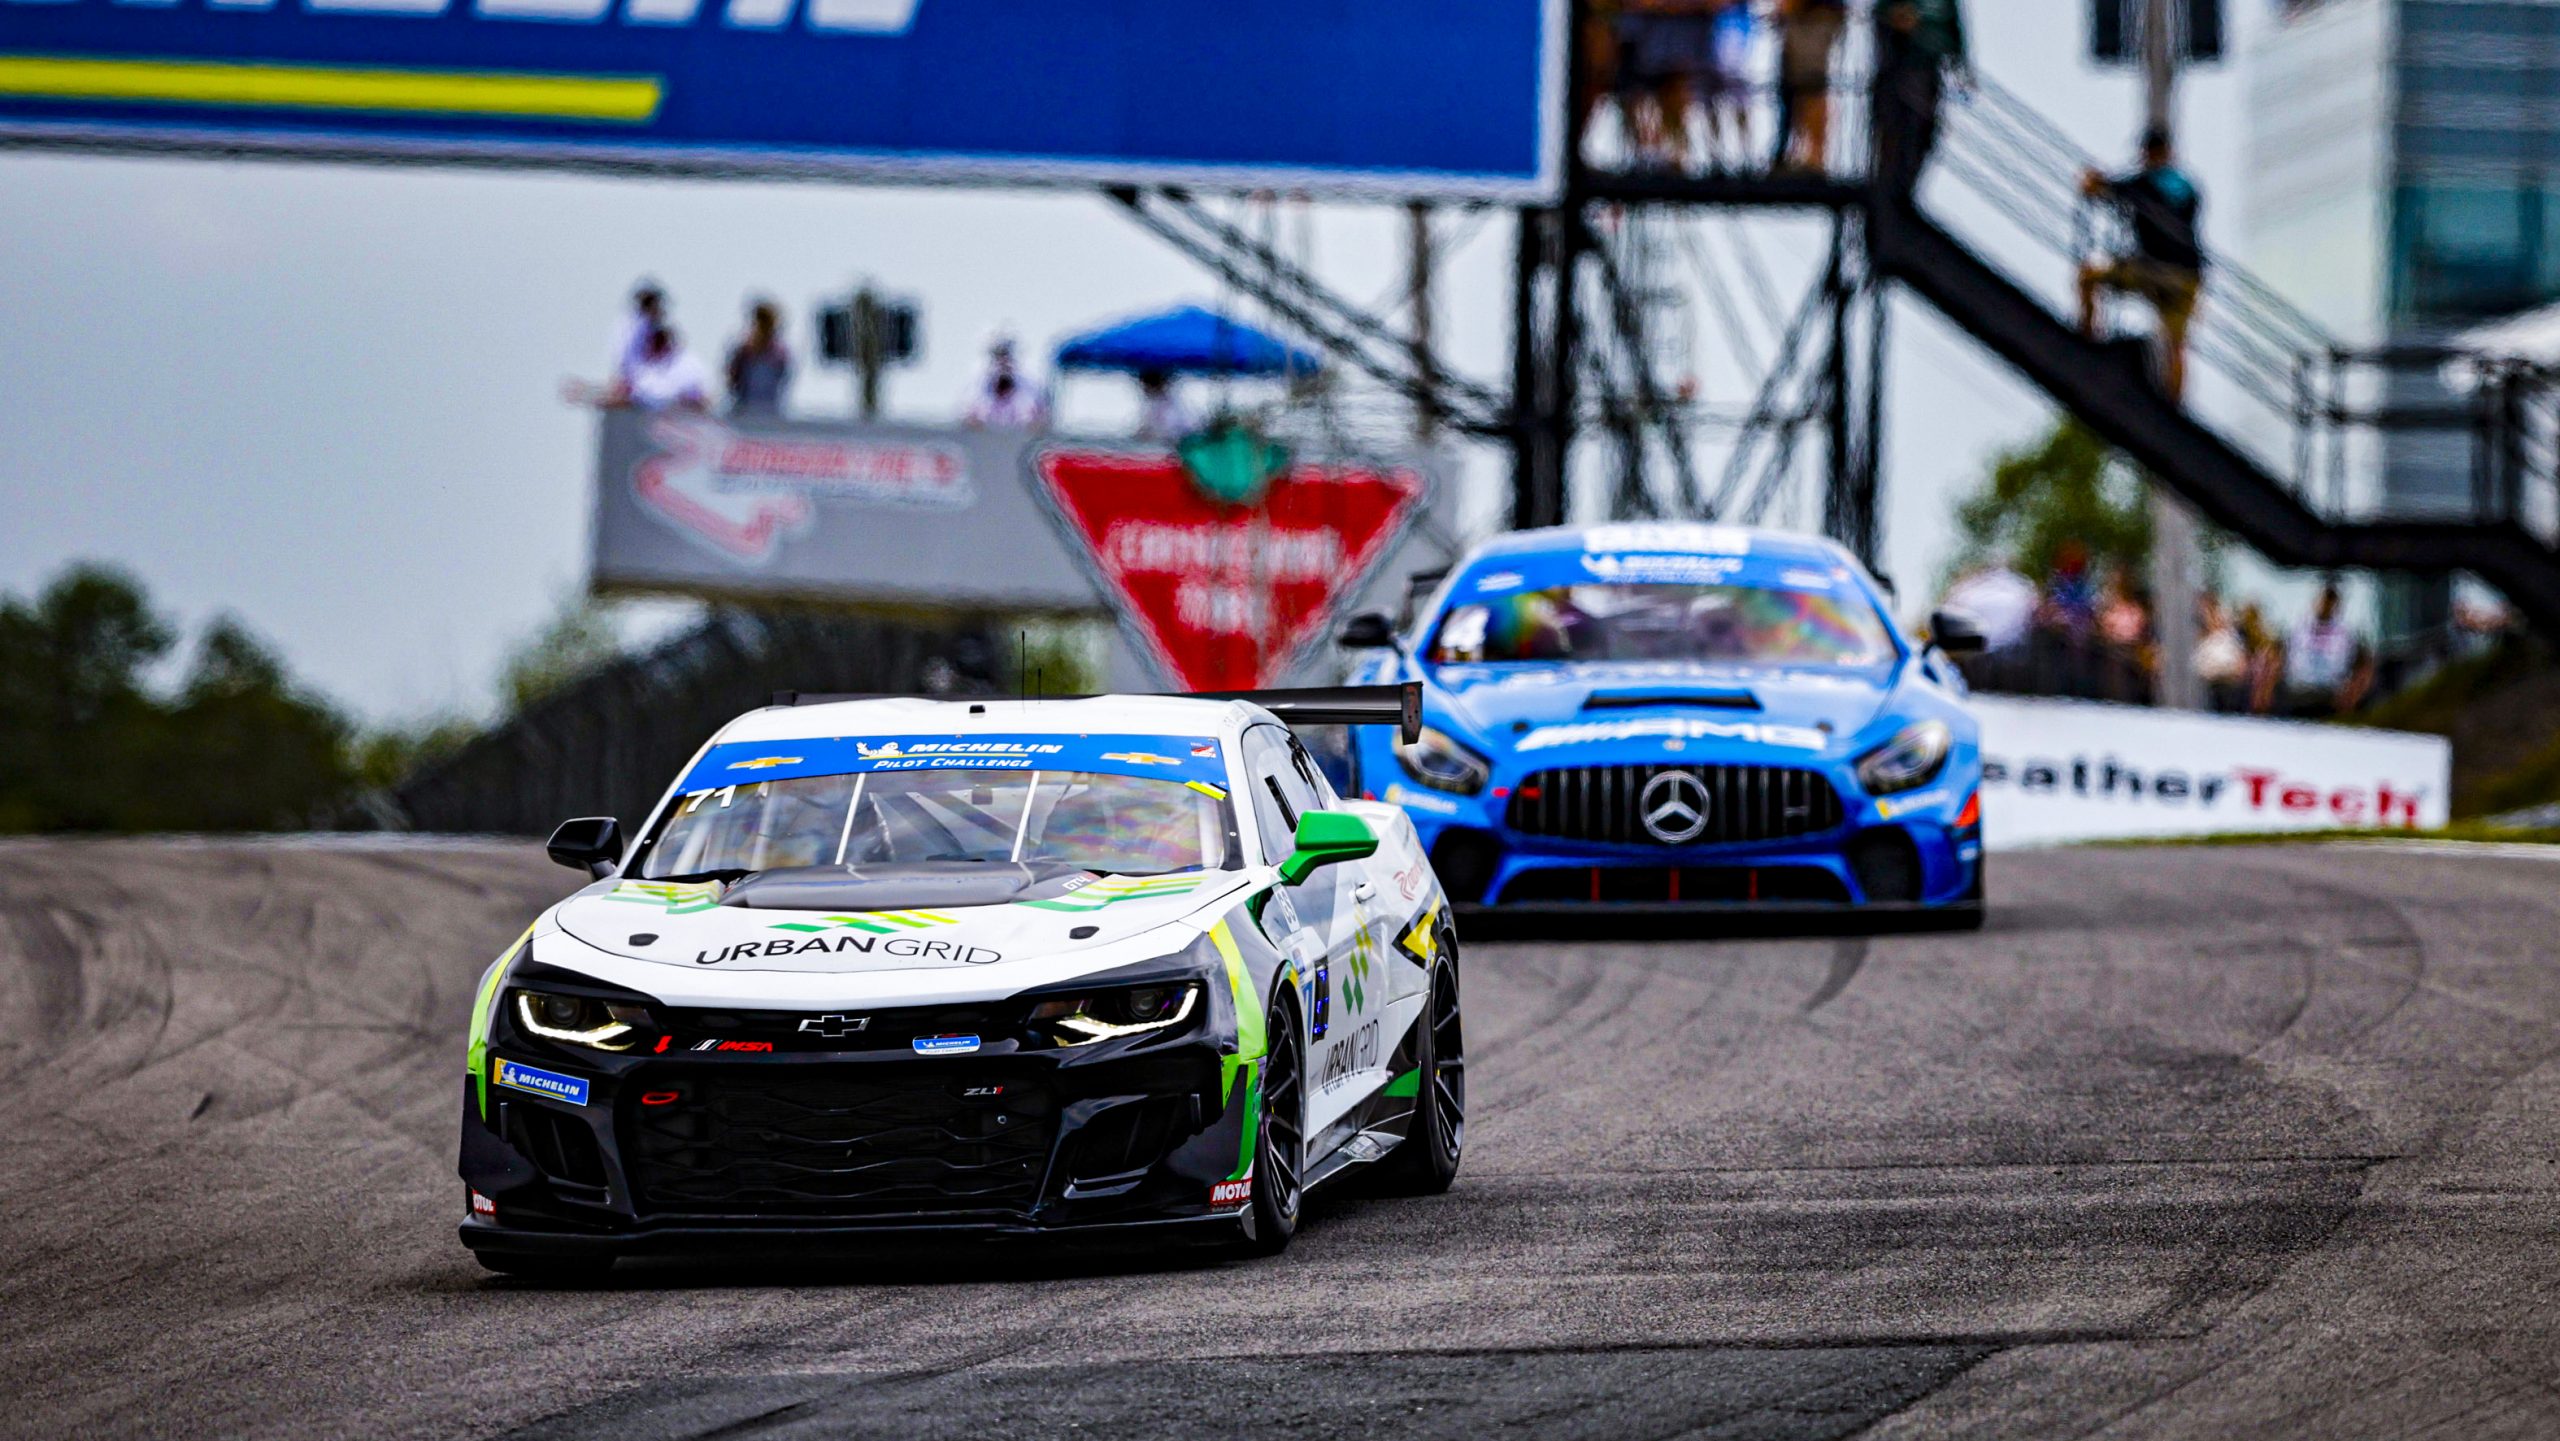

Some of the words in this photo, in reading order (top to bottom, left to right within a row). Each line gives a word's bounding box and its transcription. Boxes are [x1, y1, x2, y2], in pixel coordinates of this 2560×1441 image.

[907, 743, 1064, 754] MICHELIN
[873, 759, 928, 769] PILOT
[931, 757, 1034, 768] CHALLENGE
[686, 784, 737, 813] 71
[1982, 756, 2420, 829] eatherTech
[695, 936, 877, 965] URBAN
[884, 938, 1003, 965] GRID
[716, 1040, 773, 1053] IMSA
[518, 1073, 580, 1096] MICHELIN
[963, 1086, 1004, 1096] ZL1
[473, 1194, 494, 1211] OTUL
